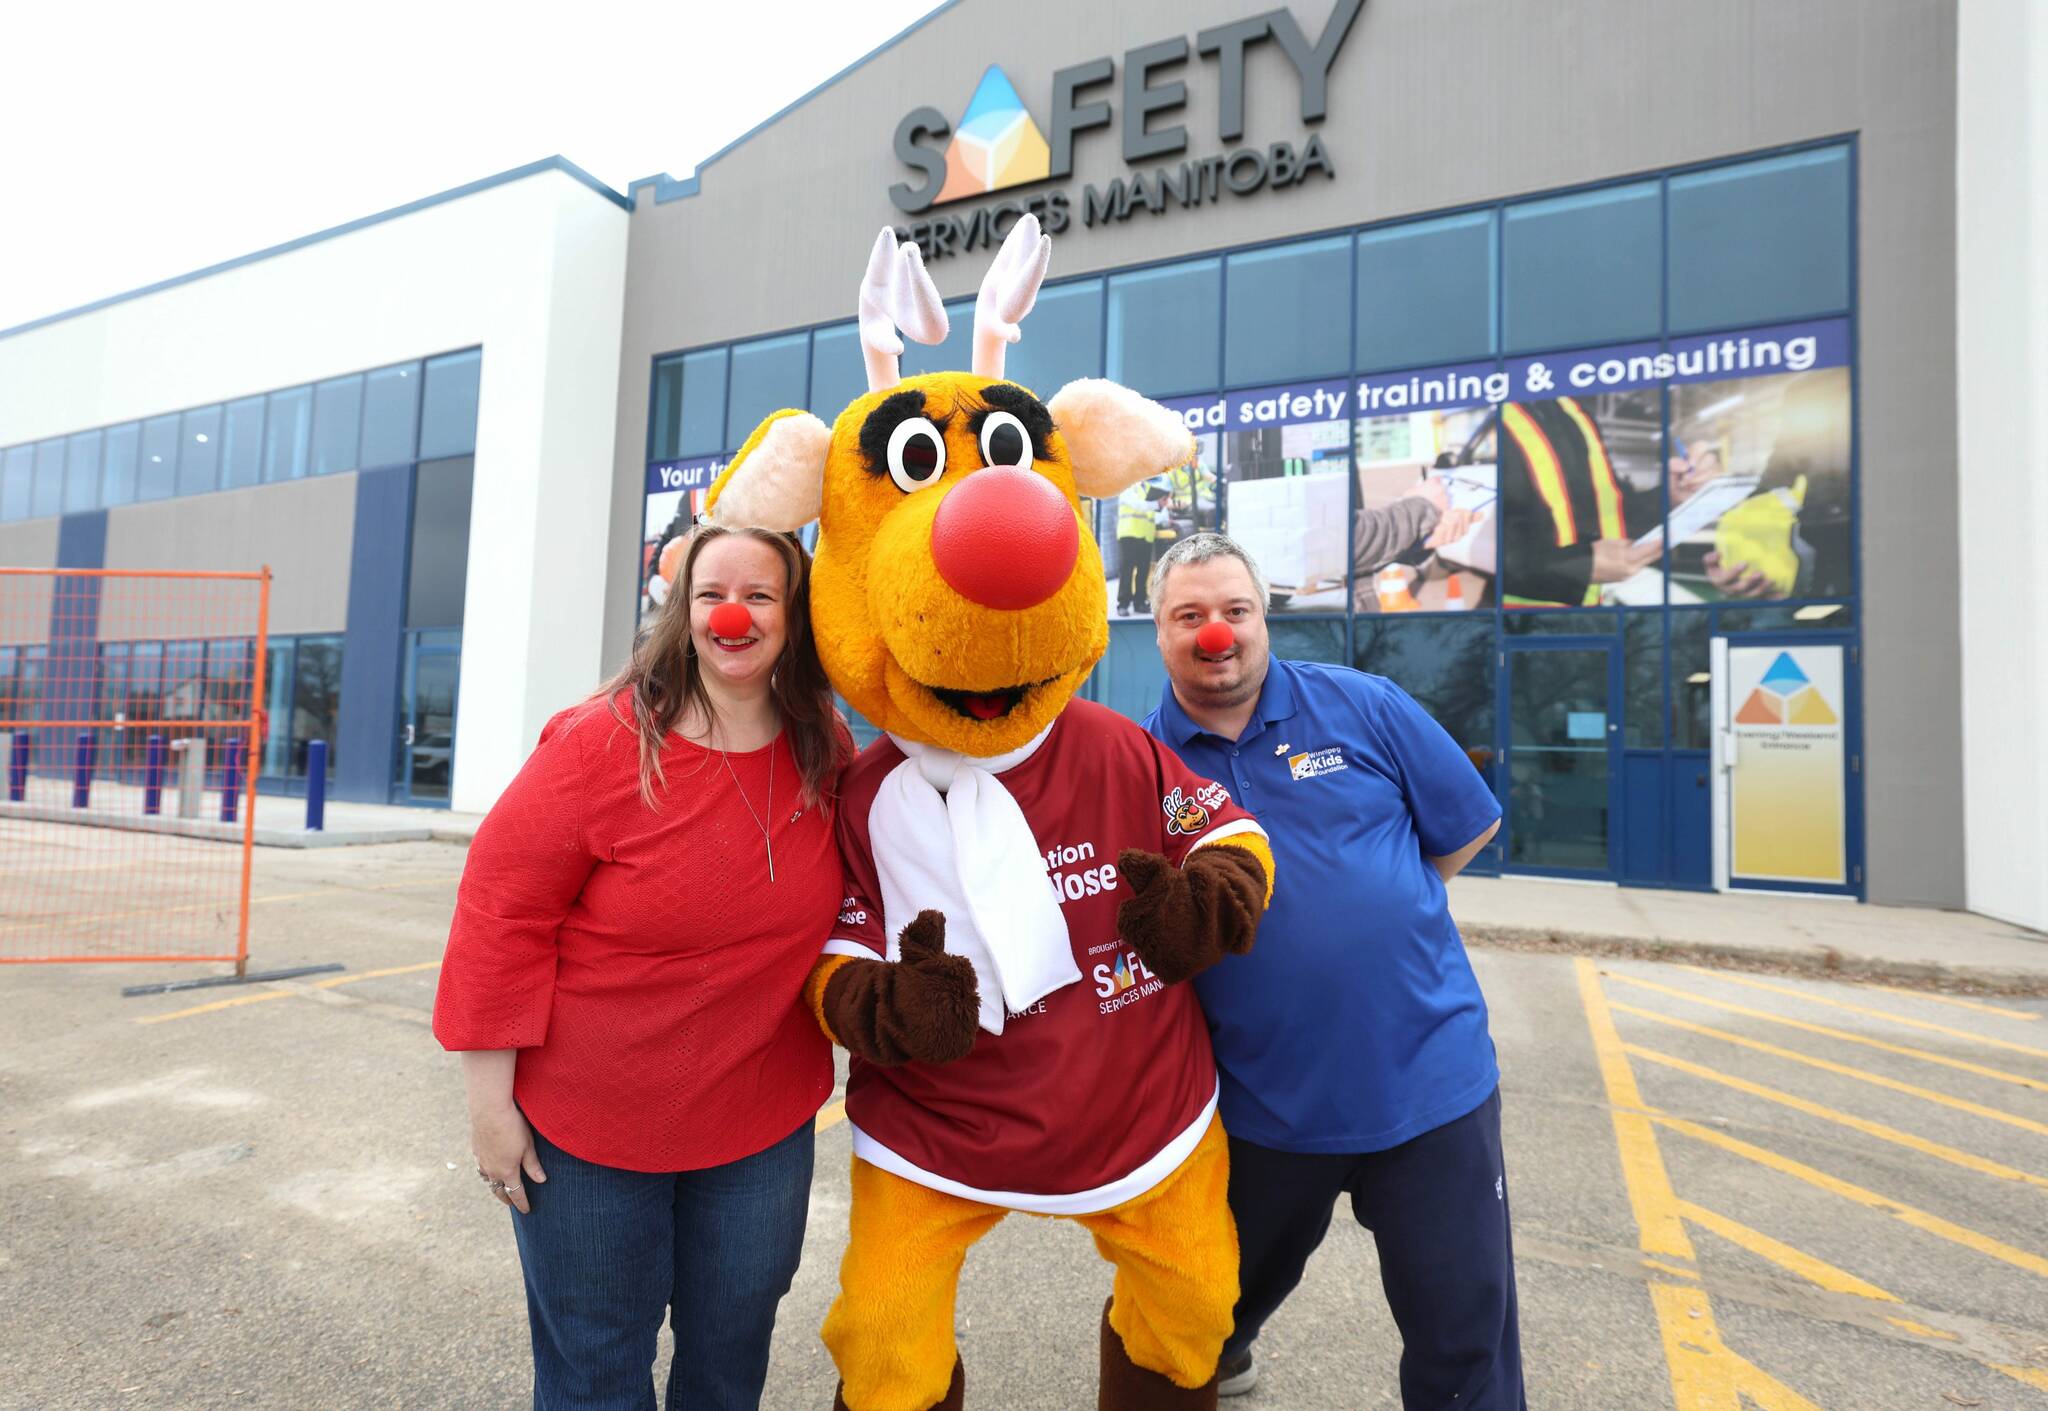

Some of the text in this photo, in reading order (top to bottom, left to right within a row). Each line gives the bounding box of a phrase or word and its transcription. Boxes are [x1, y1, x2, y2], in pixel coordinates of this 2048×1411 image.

[1082, 135, 1334, 227] MANITOBA
[660, 466, 703, 488] Your
[709, 461, 728, 483] tr
[1240, 387, 1347, 423] safety
[1357, 372, 1509, 410] training
[1525, 362, 1555, 392] &
[1568, 336, 1816, 387] consulting
[1309, 746, 1341, 759] Winnipeg
[1312, 755, 1343, 770] Kids
[1315, 764, 1348, 776] Foundation
[842, 896, 856, 908] on
[1088, 941, 1118, 956] BROUGHT
